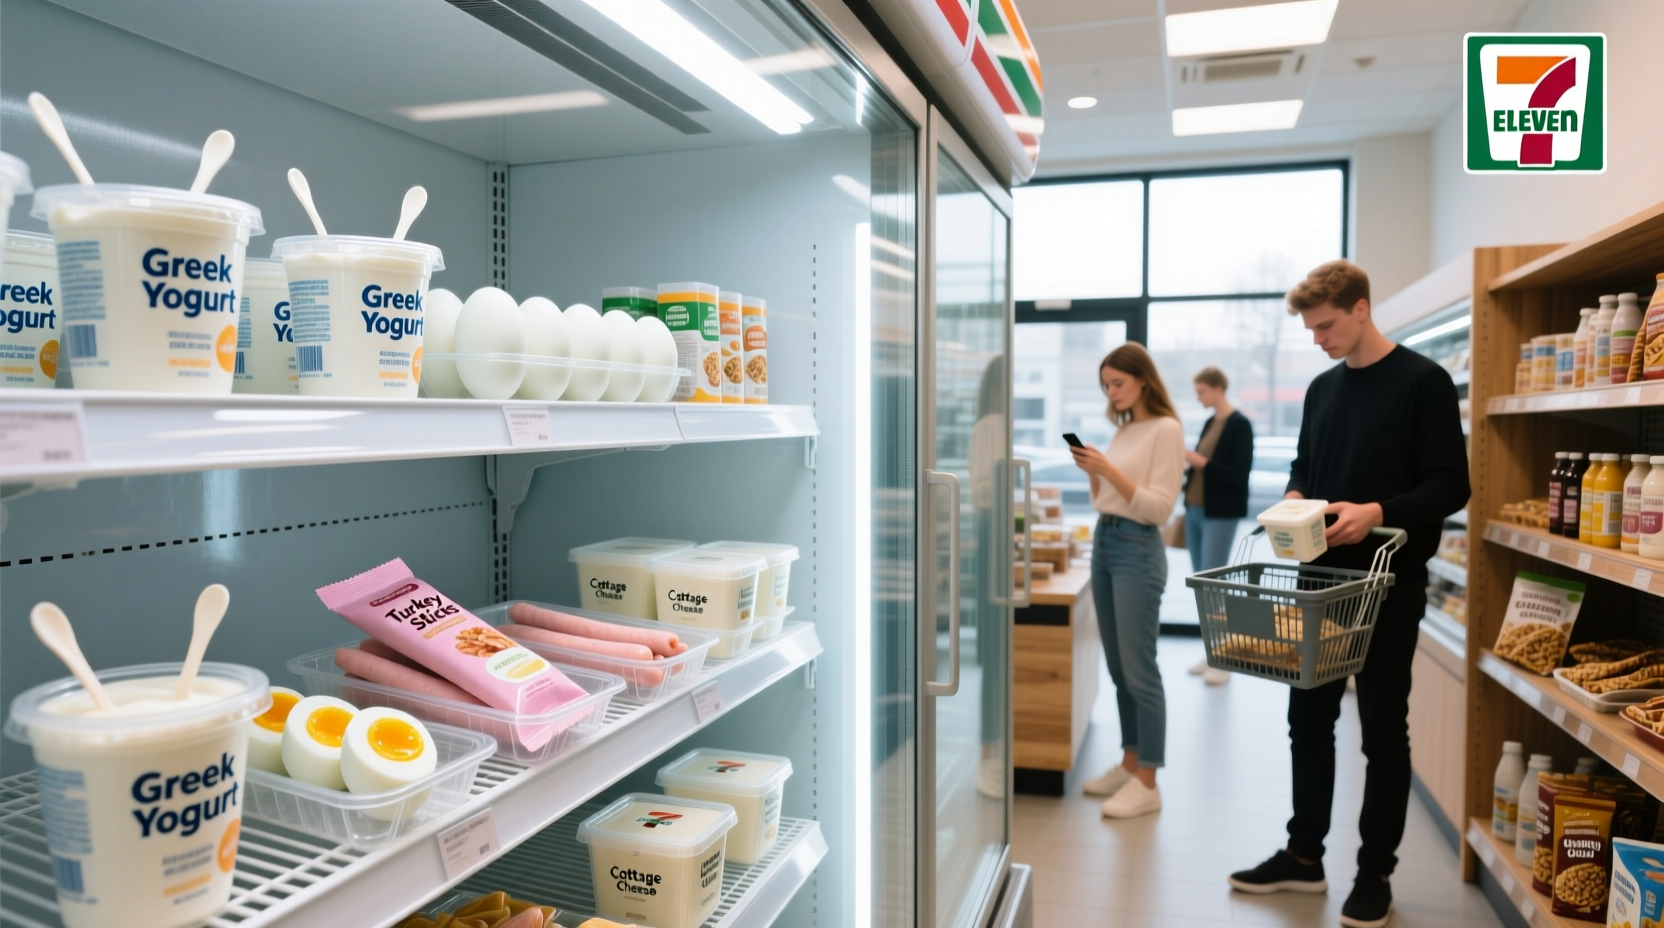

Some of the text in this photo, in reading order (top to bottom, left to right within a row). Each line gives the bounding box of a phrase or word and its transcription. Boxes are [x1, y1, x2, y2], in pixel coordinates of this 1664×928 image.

[142, 247, 232, 283] Greek
[0, 281, 53, 306] reek
[142, 280, 236, 318] Yogurt
[361, 284, 423, 312] Greek
[360, 310, 423, 341] Yogurt
[385, 594, 442, 623] Turkey
[132, 752, 235, 804] Greek
[132, 781, 239, 838] Yogurt
